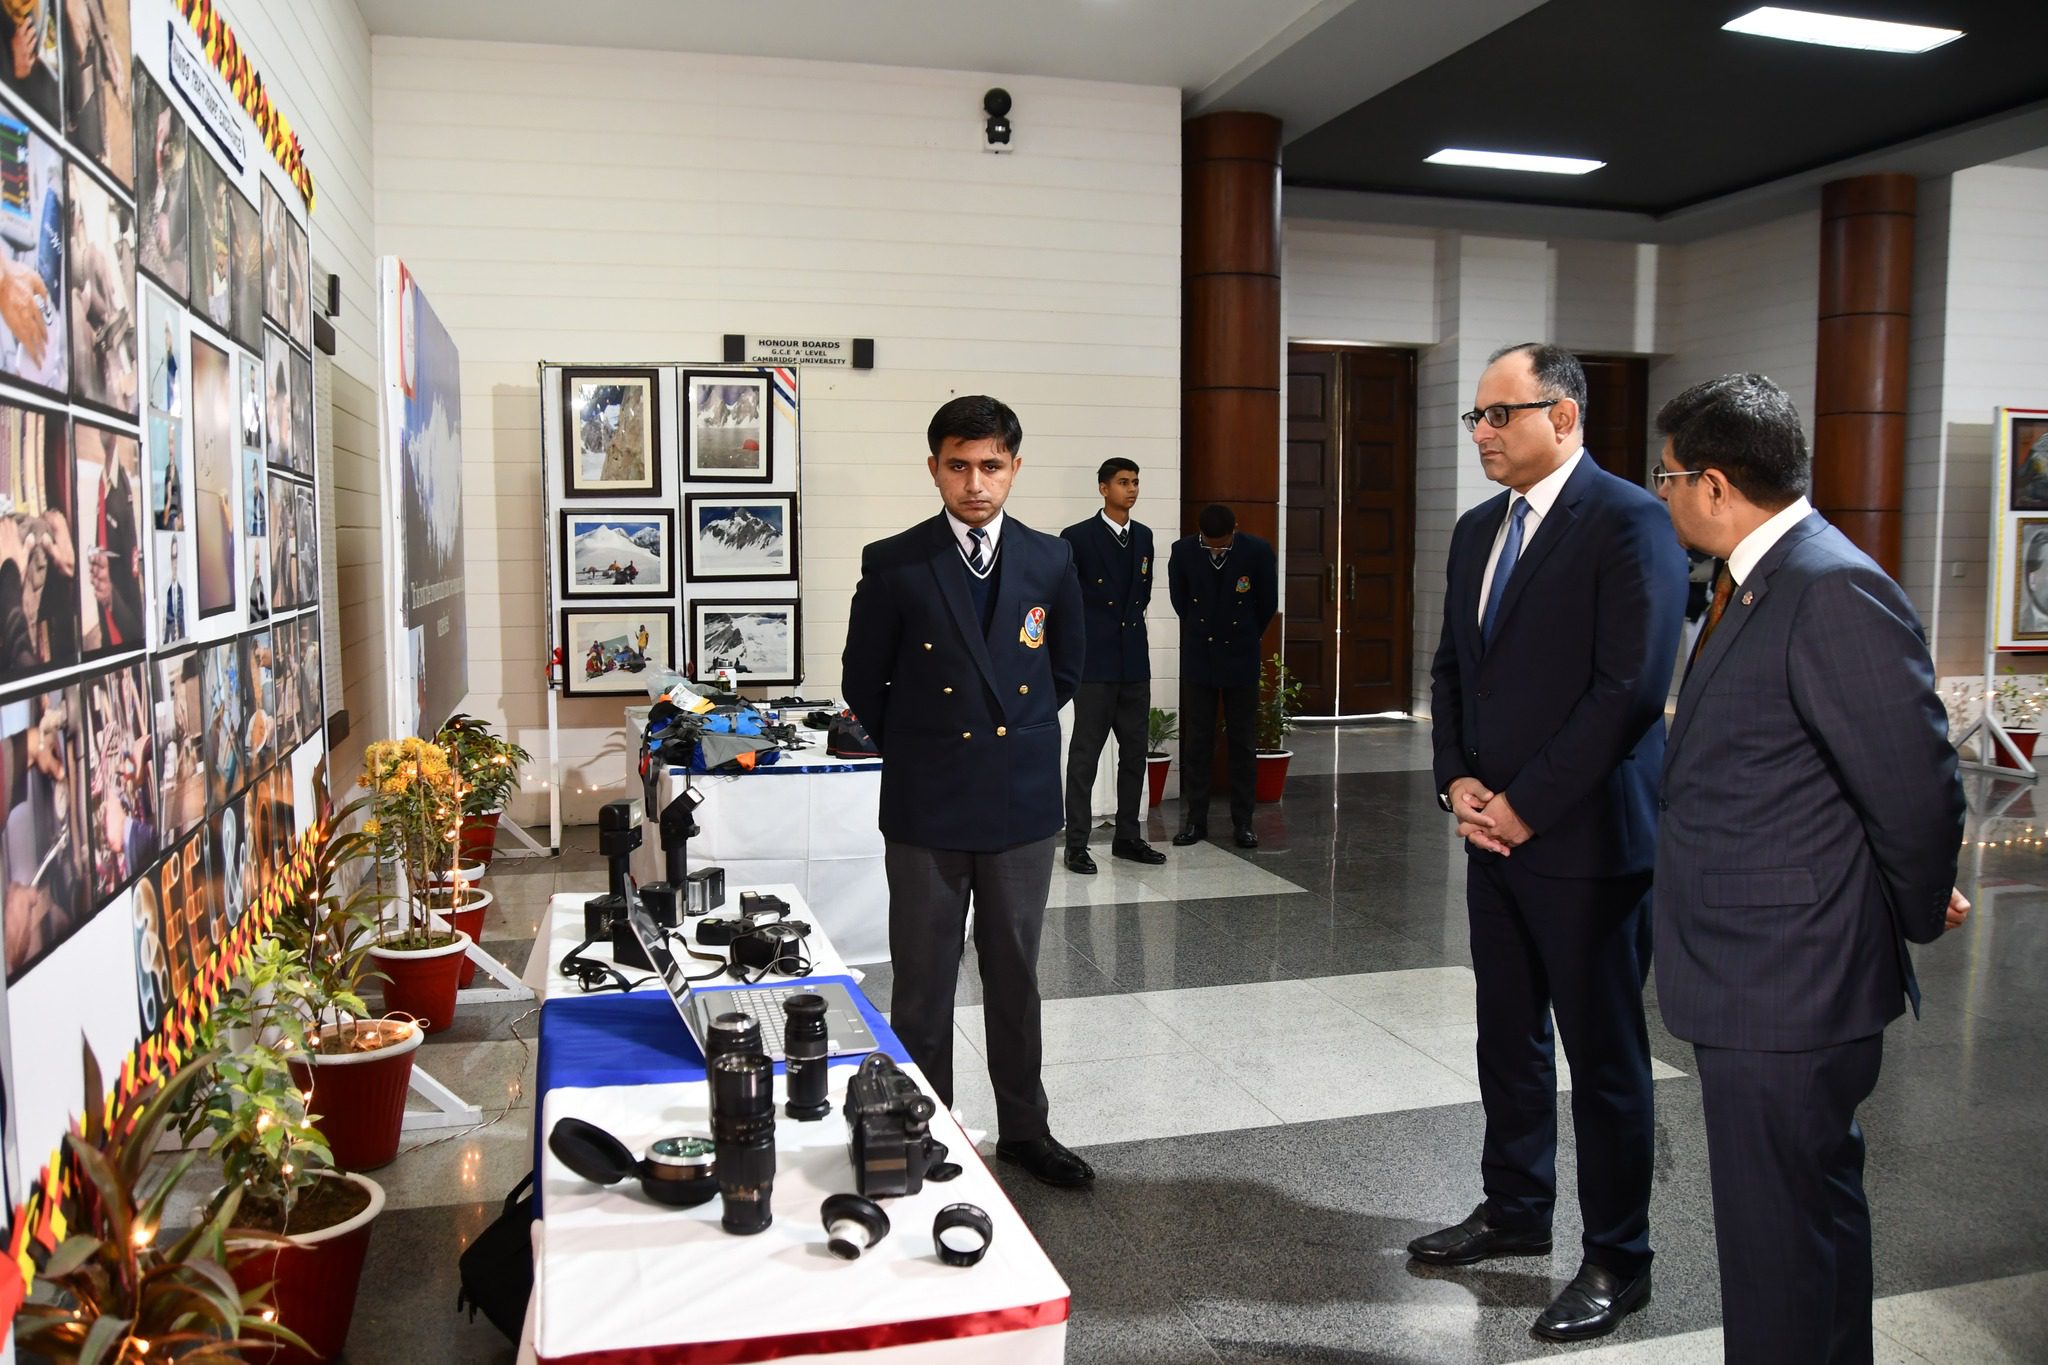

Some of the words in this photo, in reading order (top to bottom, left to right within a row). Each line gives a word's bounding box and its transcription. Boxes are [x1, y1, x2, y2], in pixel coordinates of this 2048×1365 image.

[759, 339, 799, 347] HONOUR
[802, 340, 840, 349] BOARDS
[132, 813, 227, 1031] REEL
